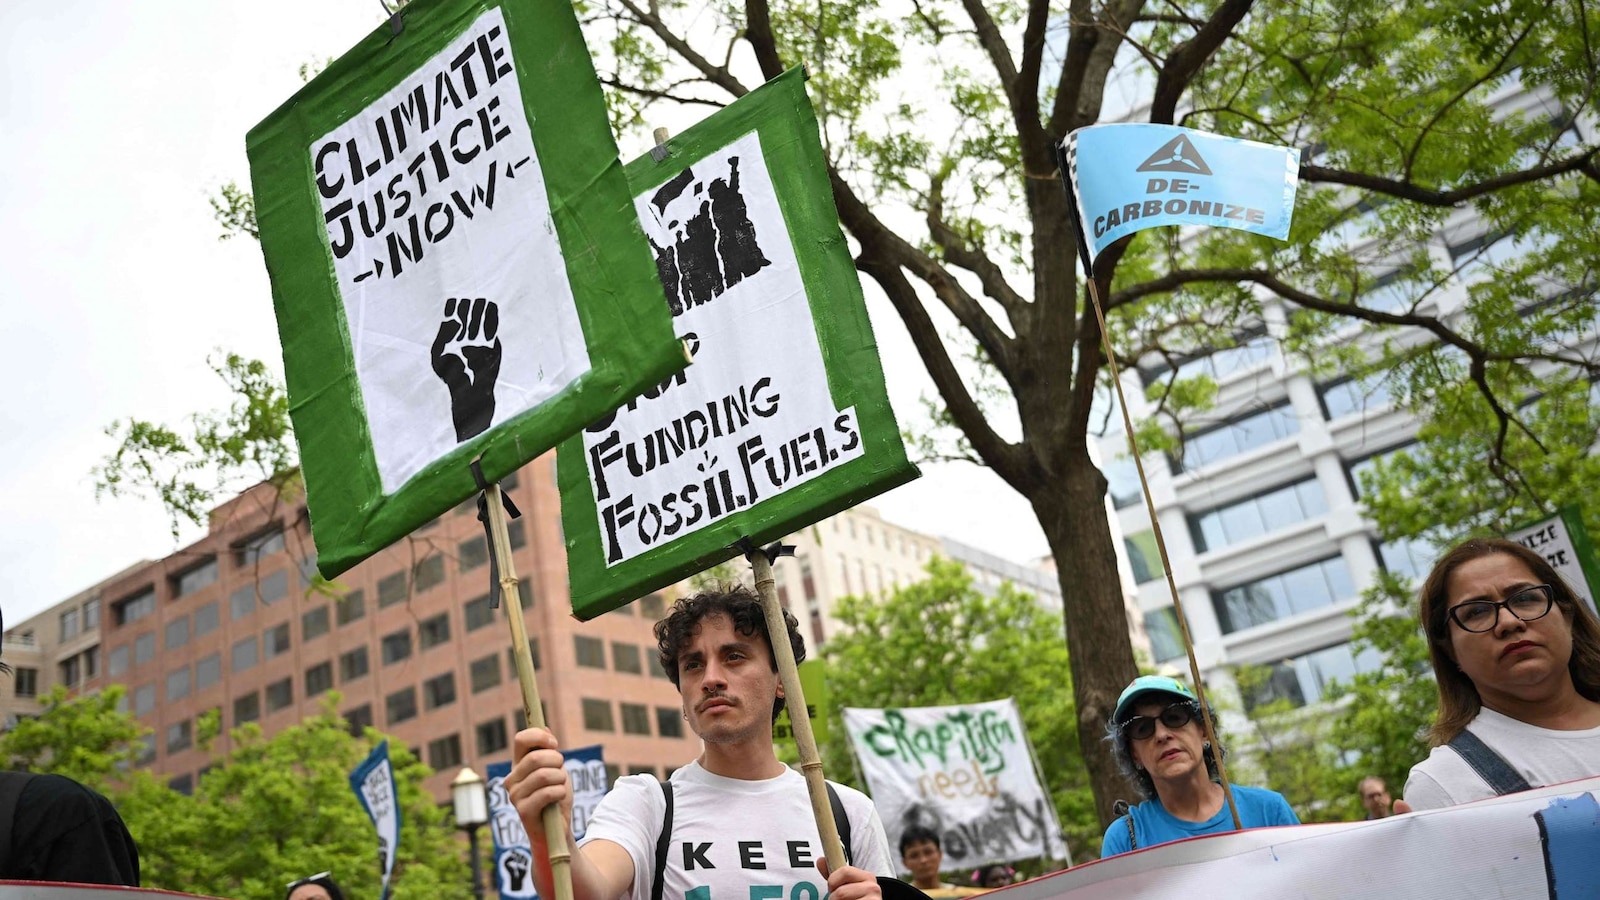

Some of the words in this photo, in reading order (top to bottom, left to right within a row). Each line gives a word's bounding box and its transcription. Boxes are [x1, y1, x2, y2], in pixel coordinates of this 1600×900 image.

[315, 25, 513, 199] CLIMATE
[324, 95, 511, 259] JUSTICE
[386, 160, 497, 278] NOW
[1093, 198, 1265, 239] CARBONIZE
[1145, 178, 1200, 194] DE-
[589, 376, 780, 502] FUNDING
[601, 469, 747, 564] FOSSIL
[737, 413, 859, 505] FUELS
